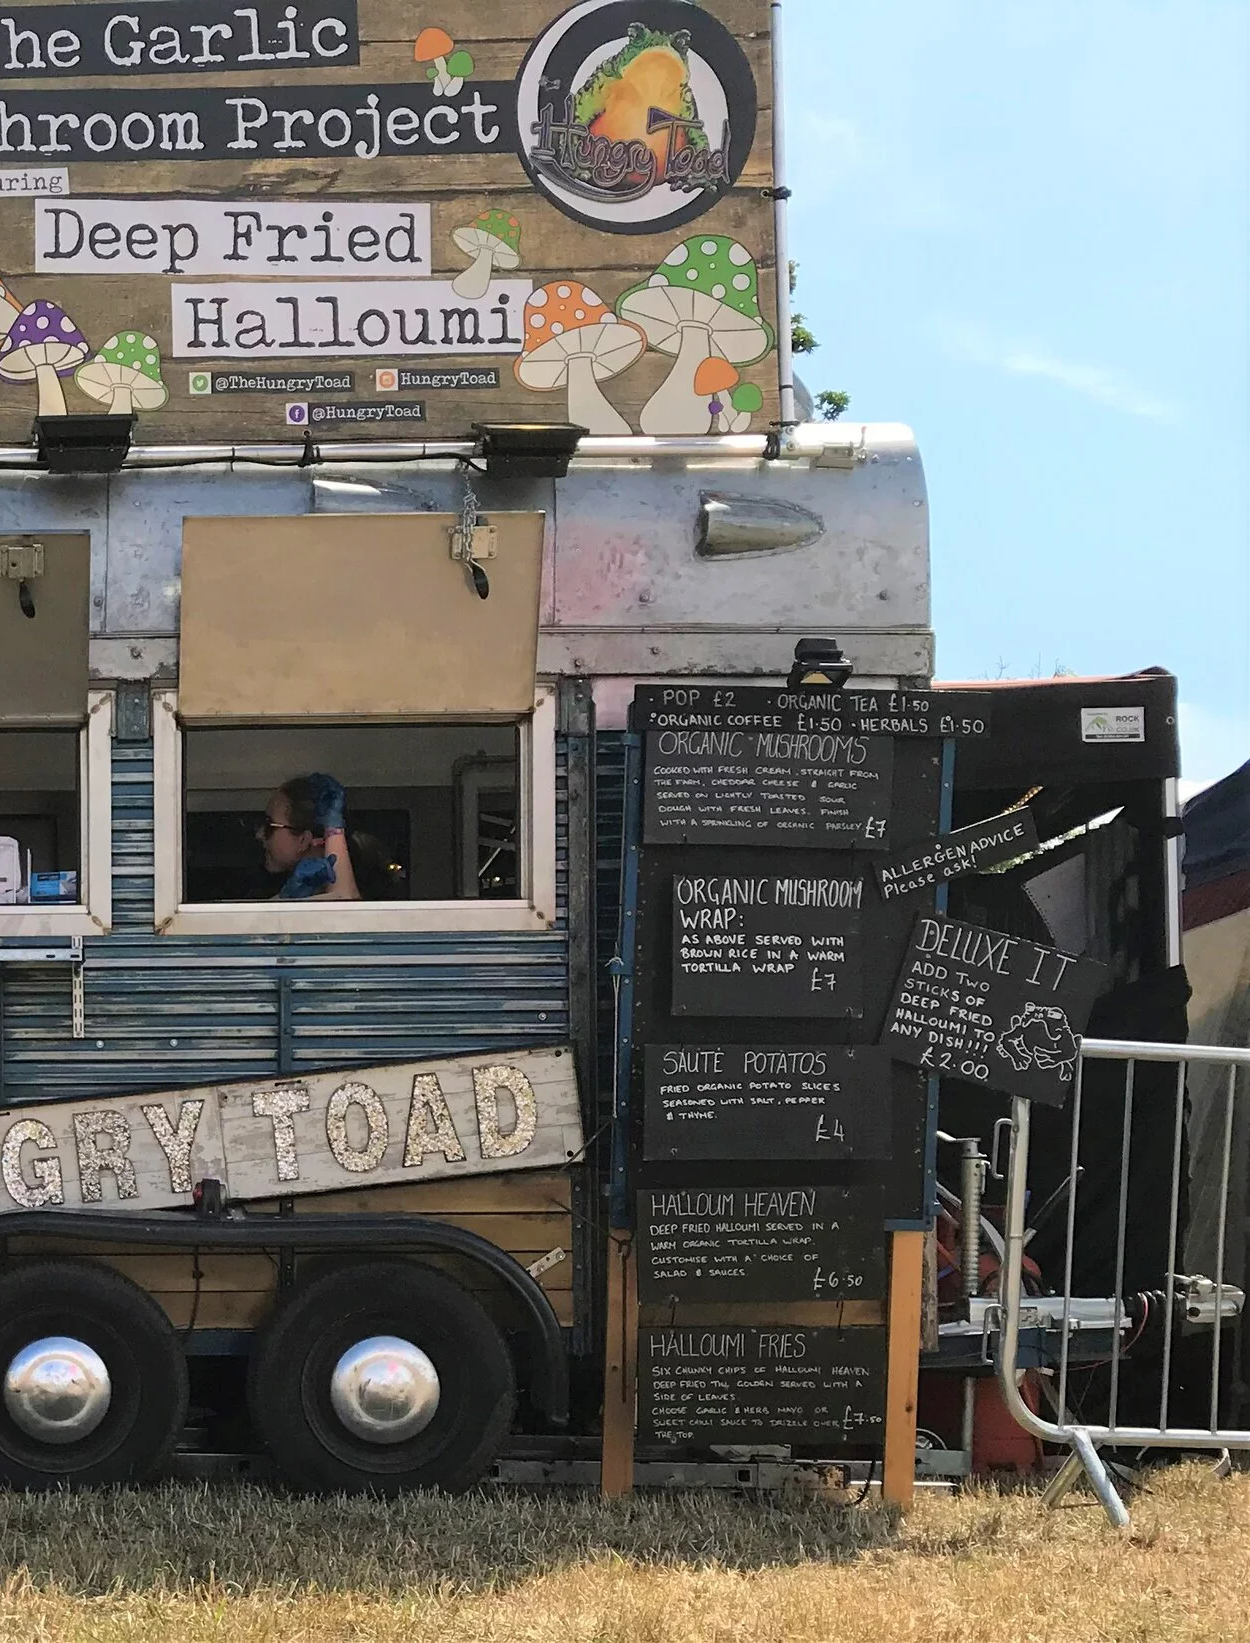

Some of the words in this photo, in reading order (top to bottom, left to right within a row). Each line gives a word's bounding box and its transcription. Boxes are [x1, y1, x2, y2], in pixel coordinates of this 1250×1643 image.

[103, 5, 349, 67] Garlic
[225, 91, 500, 160] Project
[43, 207, 200, 274] Deep
[223, 211, 423, 263] Fried
[185, 293, 522, 349] Halloumi
[215, 375, 352, 392] @TheHungryToad
[401, 371, 497, 389] HungryToad
[312, 404, 422, 422] @HungryToad
[663, 690, 700, 706] POP
[713, 691, 736, 707] £2
[777, 694, 842, 712] ORGANIC
[851, 696, 878, 712] TEA
[657, 714, 722, 727] ORGANIC
[727, 715, 782, 728] COFFEE
[861, 717, 929, 732] HERBALS
[1115, 715, 1140, 723] ROCK
[658, 731, 744, 757] ORGANIC
[755, 733, 870, 765] MUSHROOMS
[653, 765, 691, 775] COOKED
[692, 766, 714, 775] WITH
[717, 765, 749, 775] FRESH
[849, 769, 880, 780] FROM
[653, 778, 672, 787] THE
[710, 778, 757, 787] CHEDDAR
[761, 779, 800, 788] CHEESE
[827, 781, 858, 790] GARLIC
[656, 791, 691, 800] SERVED
[694, 792, 709, 800] ON
[714, 792, 753, 800] LIGHTLY
[759, 792, 807, 801] TOASTED
[818, 795, 847, 804] SOUR
[657, 804, 692, 813] DOUGH
[698, 805, 723, 813] WITH
[729, 805, 762, 813] FRESH
[820, 808, 850, 817] FINISH
[659, 818, 687, 827] WITH
[690, 818, 699, 827] A
[756, 820, 769, 828] OF
[776, 821, 815, 830] ORGANIC
[865, 816, 887, 839] £7
[881, 845, 967, 882] ALLERGEN
[969, 823, 1025, 853] ADVICE
[884, 871, 936, 899] Please
[943, 856, 978, 878] ask!
[677, 876, 769, 905] ORGANIC
[774, 878, 863, 909] MUSHROOM
[680, 907, 745, 930] WRAP:
[681, 934, 700, 945] AS
[705, 934, 746, 945] ABOVE
[755, 935, 802, 946] SERVED
[811, 936, 844, 947] WITH
[680, 948, 723, 959] BROWN
[728, 948, 758, 959] RICE
[767, 949, 781, 960] IN
[789, 949, 799, 960] A
[807, 950, 846, 962] WARM
[915, 919, 1019, 975] DELUXE
[1026, 947, 1077, 991] IT
[681, 962, 741, 974] TORTILLA
[752, 963, 795, 974] WRAP
[911, 960, 948, 980] ADD
[955, 972, 990, 992] TWO
[811, 967, 837, 991] £7
[904, 978, 960, 1002] STICKS
[965, 995, 986, 1007] OF
[900, 992, 940, 1010] DEEP
[949, 1005, 993, 1026] FRIED
[895, 1007, 967, 1035] HALLOUMI
[973, 1028, 996, 1042] TO
[890, 1021, 922, 1039] ANY
[928, 1031, 989, 1059] DISH!!!
[744, 1051, 827, 1076] POTATOS
[659, 1084, 690, 1095] FRIED
[696, 1082, 743, 1092] ORGANIC
[749, 1081, 792, 1091] POTATO
[801, 1081, 841, 1092] SLICES
[662, 1098, 716, 1108] SEASONED
[720, 1096, 744, 1105] WITH
[784, 1096, 826, 1105] PEPPER
[251, 1063, 540, 1183] TOAD
[815, 1113, 846, 1143] £4
[743, 1190, 817, 1217] HEAVEN
[649, 1223, 678, 1237] DEEP
[681, 1223, 711, 1234] FRIED
[715, 1222, 760, 1232] HALLOUMI
[765, 1222, 804, 1232] SERVED
[811, 1221, 825, 1231] IN
[831, 1221, 840, 1231] A
[650, 1240, 676, 1251] WARM
[682, 1239, 722, 1249] ORGANIC
[726, 1237, 778, 1247] TORTILLA
[651, 1255, 708, 1266] CUSTOMISE
[713, 1255, 738, 1263] WITH
[744, 1255, 752, 1263] A
[760, 1253, 794, 1263] CHOICE
[803, 1253, 820, 1262] OF
[653, 1269, 688, 1279] SALAD
[650, 1333, 745, 1359] HALLOUMI
[758, 1333, 806, 1358] FRIES
[652, 1365, 671, 1377] SIX
[675, 1365, 712, 1375] CHUNKY
[717, 1366, 747, 1375] CHIPS
[831, 1365, 870, 1377] HEAVEN
[653, 1380, 677, 1390] DEEP
[679, 1380, 707, 1389] FRIED
[780, 1380, 816, 1389] SERVED
[823, 1381, 848, 1389] WITH
[855, 1380, 863, 1388] A
[653, 1392, 676, 1401] SIDE
[680, 1393, 694, 1401] OF
[698, 1393, 736, 1401] LEAVES
[651, 1406, 688, 1416] CHOOSE
[695, 1406, 727, 1415] GARLIC
[743, 1406, 770, 1415] HERB
[814, 1406, 829, 1414] OR
[652, 1418, 685, 1428] SWEET
[689, 1418, 713, 1427] CHILLI
[720, 1419, 748, 1427] SAUCE
[751, 1419, 764, 1427] TO
[813, 1420, 841, 1428] OVER
[654, 1430, 672, 1440] THE
